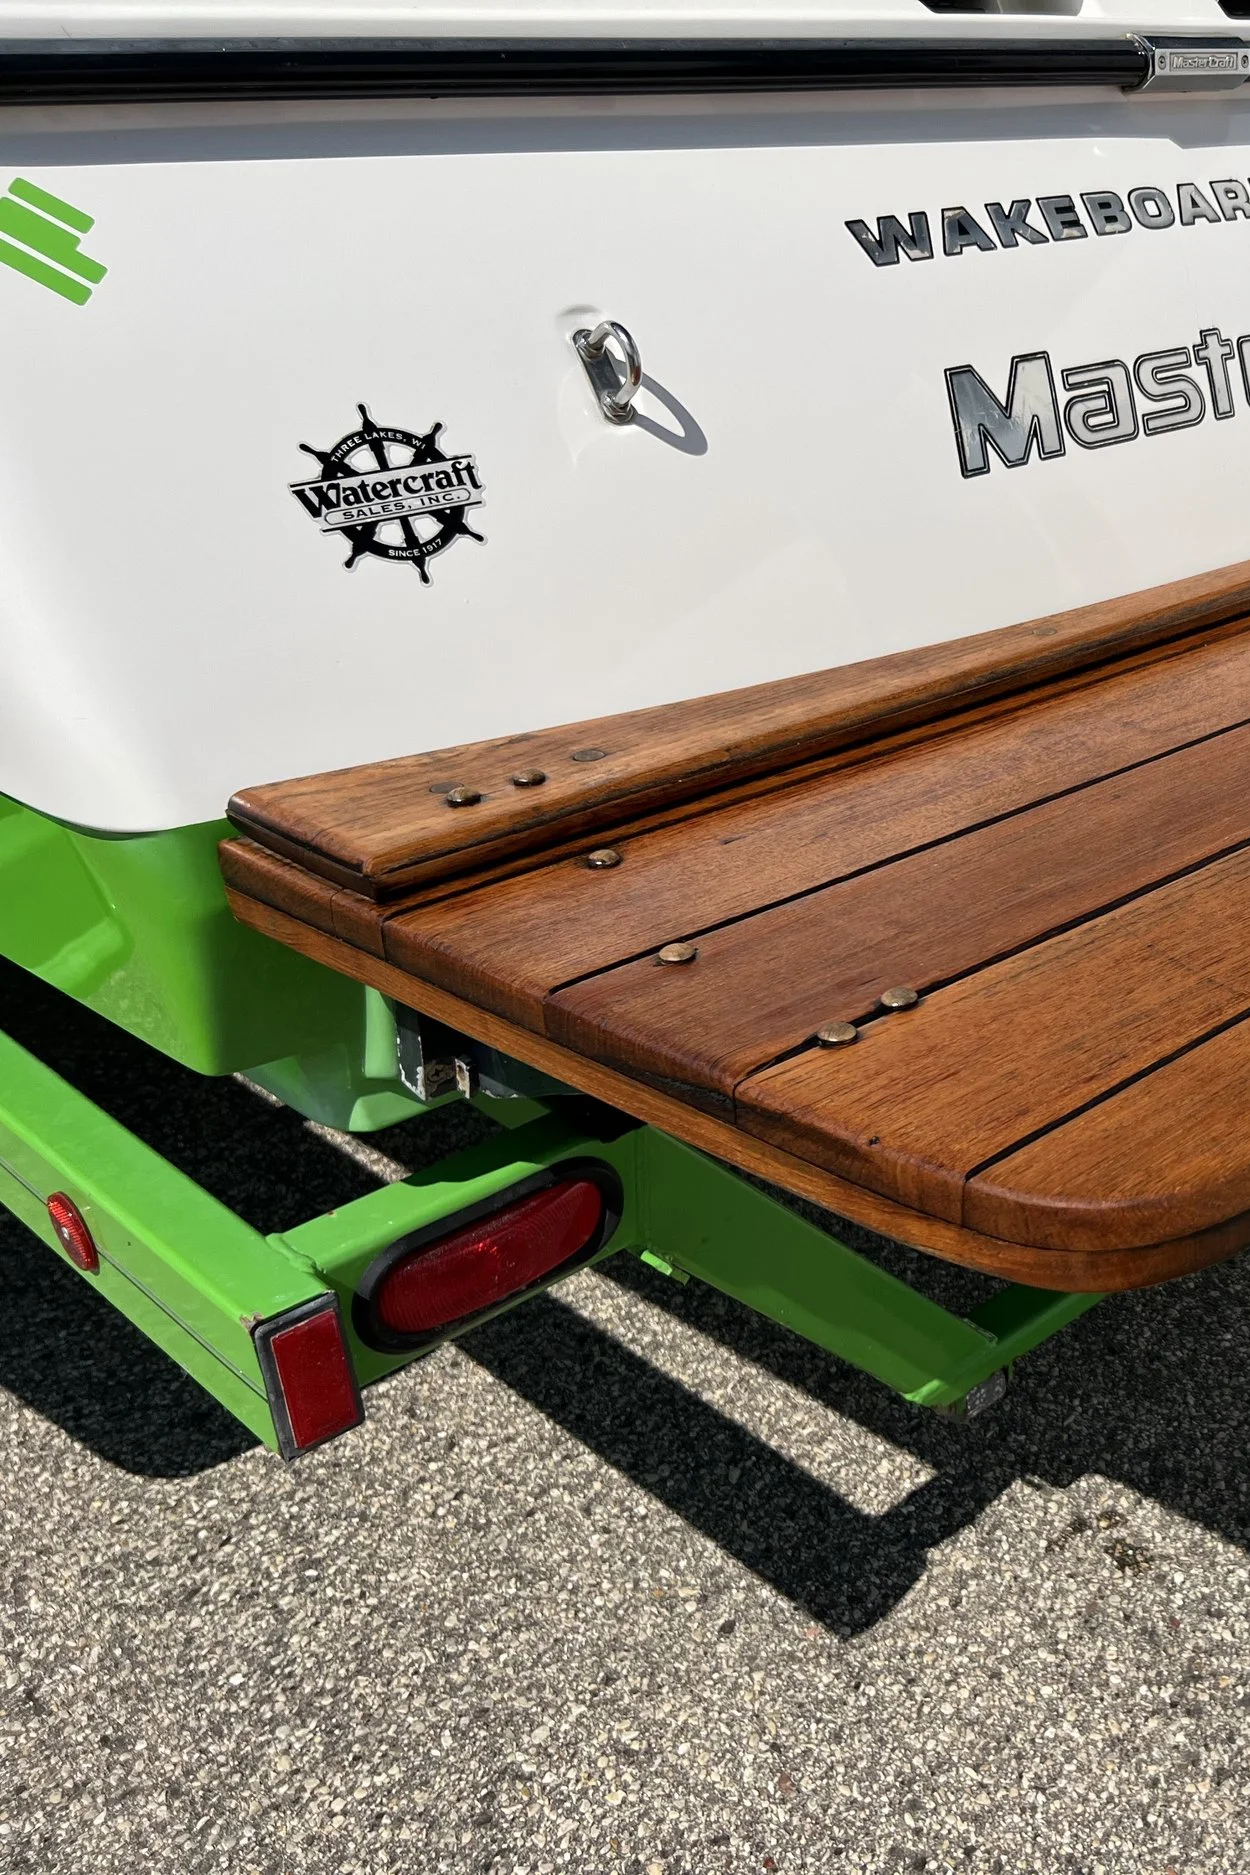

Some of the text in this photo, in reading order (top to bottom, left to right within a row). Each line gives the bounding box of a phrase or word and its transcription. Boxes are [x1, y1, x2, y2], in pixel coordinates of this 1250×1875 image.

[1172, 55, 1236, 69] MasterCraft
[331, 431, 427, 464] THREE LAKES, WI
[292, 460, 482, 519] Watercraft
[342, 492, 461, 520] SALES, INC.
[388, 538, 443, 558] SINCE 1917
